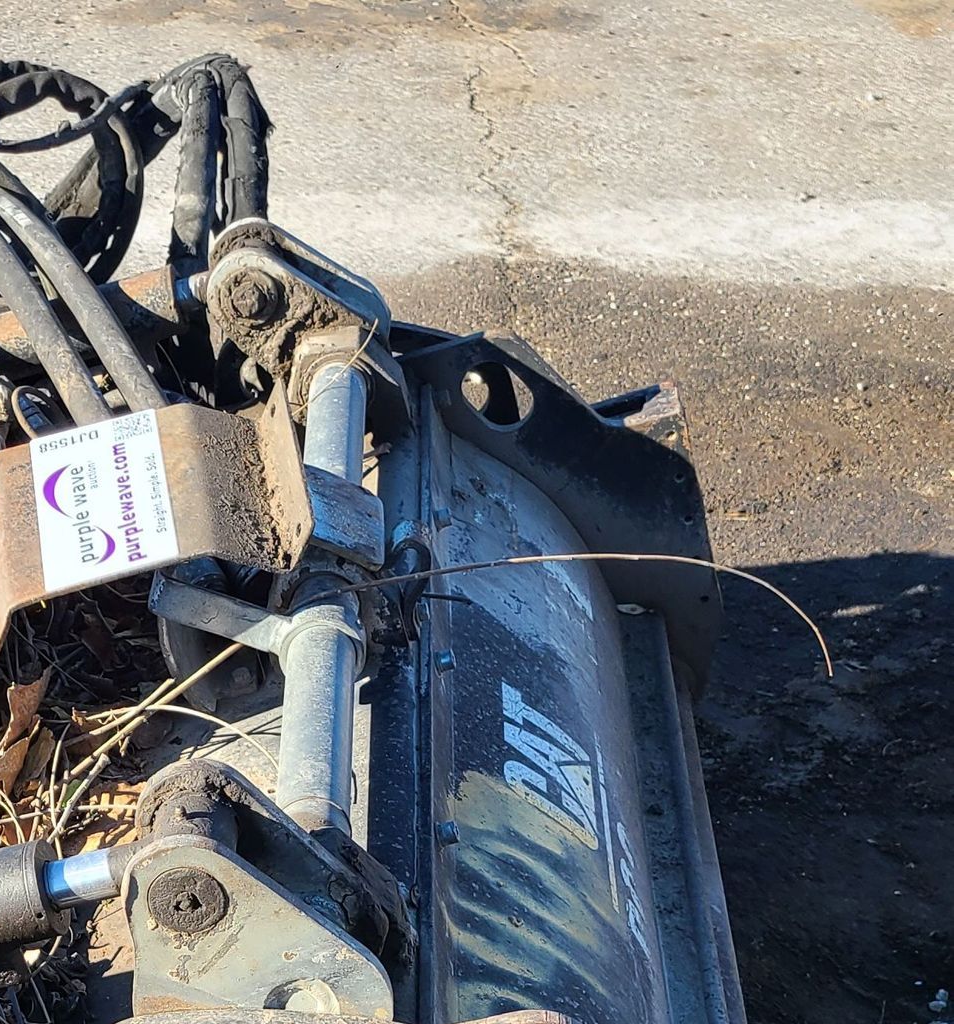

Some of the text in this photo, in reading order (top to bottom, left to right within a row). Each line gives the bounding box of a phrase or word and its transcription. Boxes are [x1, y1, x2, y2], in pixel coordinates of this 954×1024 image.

[39, 429, 99, 454] DJ1558
[87, 462, 99, 490] auction
[70, 465, 99, 563] purple wave
[112, 442, 147, 563] purplewave.com
[145, 452, 168, 534] Straight. Simple. Sold.
[501, 681, 599, 850] CAT
